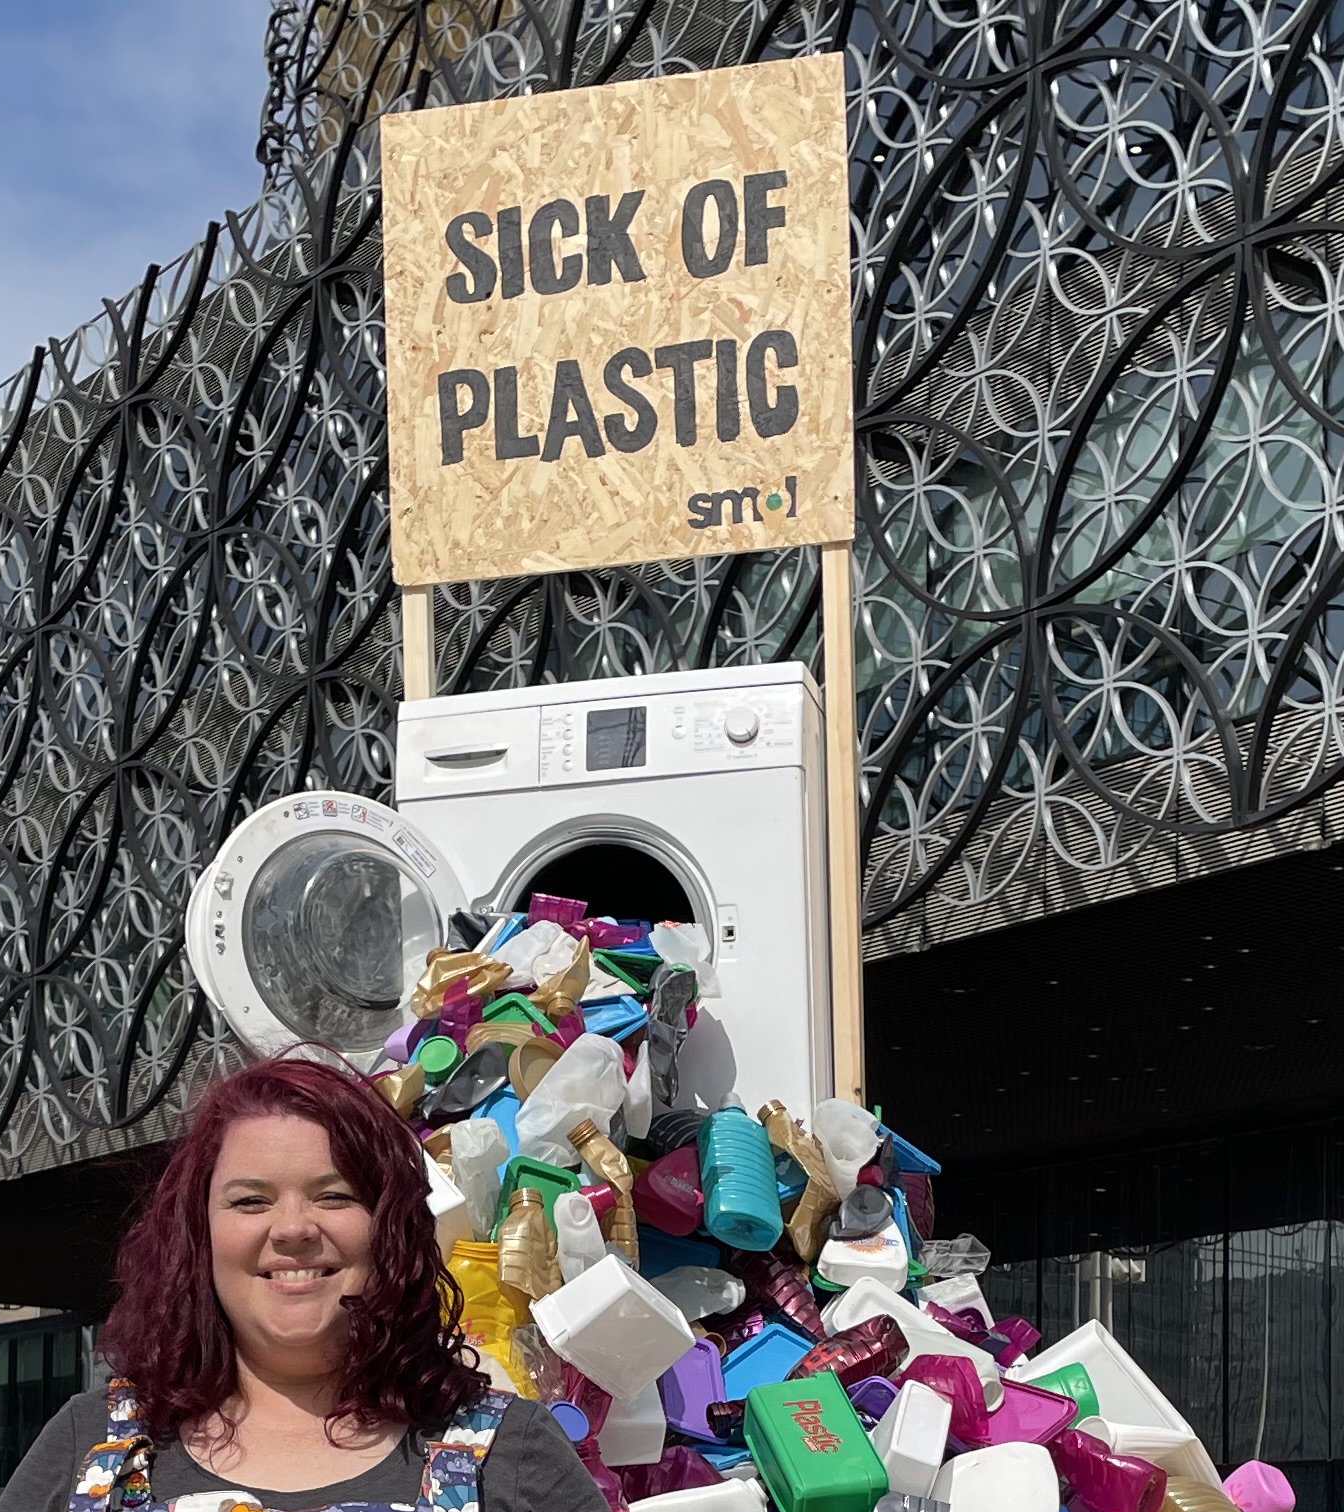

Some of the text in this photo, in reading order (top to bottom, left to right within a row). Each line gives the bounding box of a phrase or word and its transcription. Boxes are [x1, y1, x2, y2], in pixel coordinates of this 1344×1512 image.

[444, 170, 788, 304] SICK OF
[437, 329, 799, 467] PLASTIC
[782, 1399, 843, 1455] Plastic
